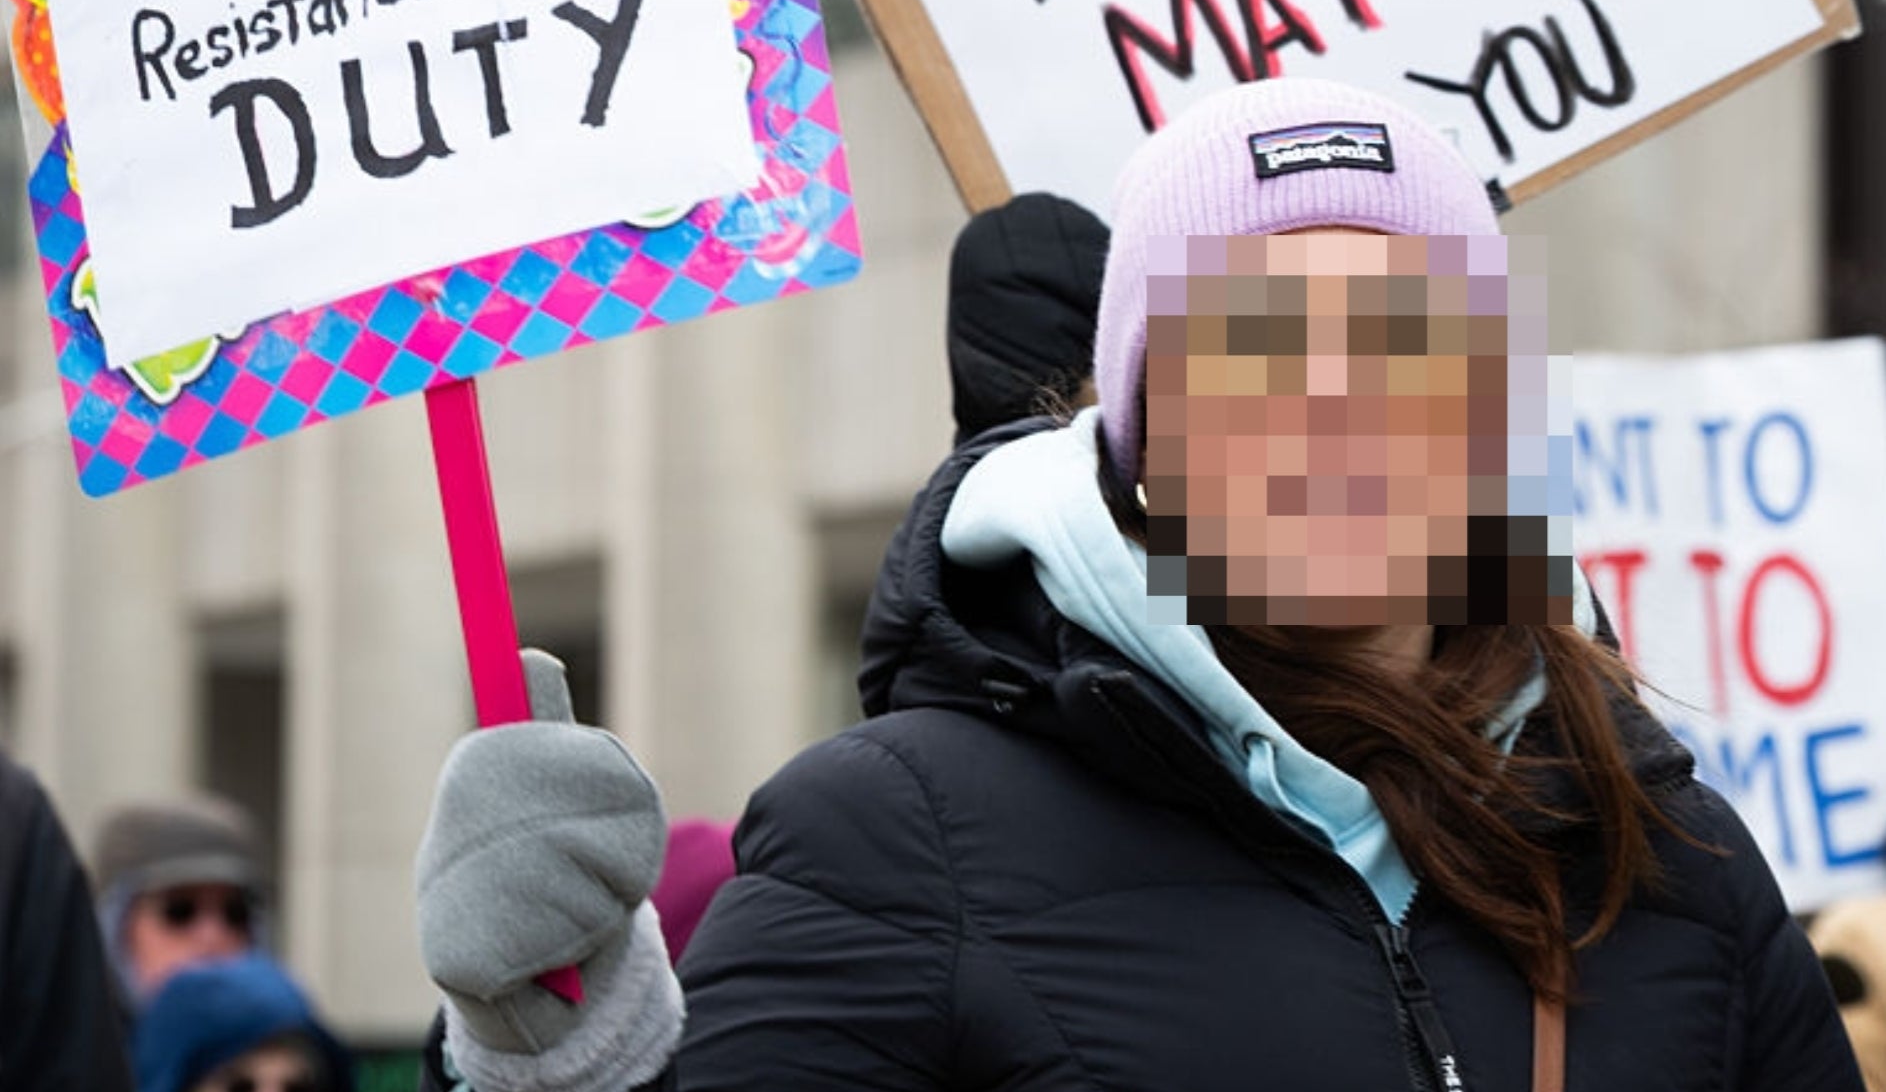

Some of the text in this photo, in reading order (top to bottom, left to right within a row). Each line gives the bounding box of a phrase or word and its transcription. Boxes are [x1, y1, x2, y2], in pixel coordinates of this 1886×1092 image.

[1266, 143, 1384, 169] patagonia
[1694, 408, 1814, 526] TO
[1688, 548, 1835, 716] TO
